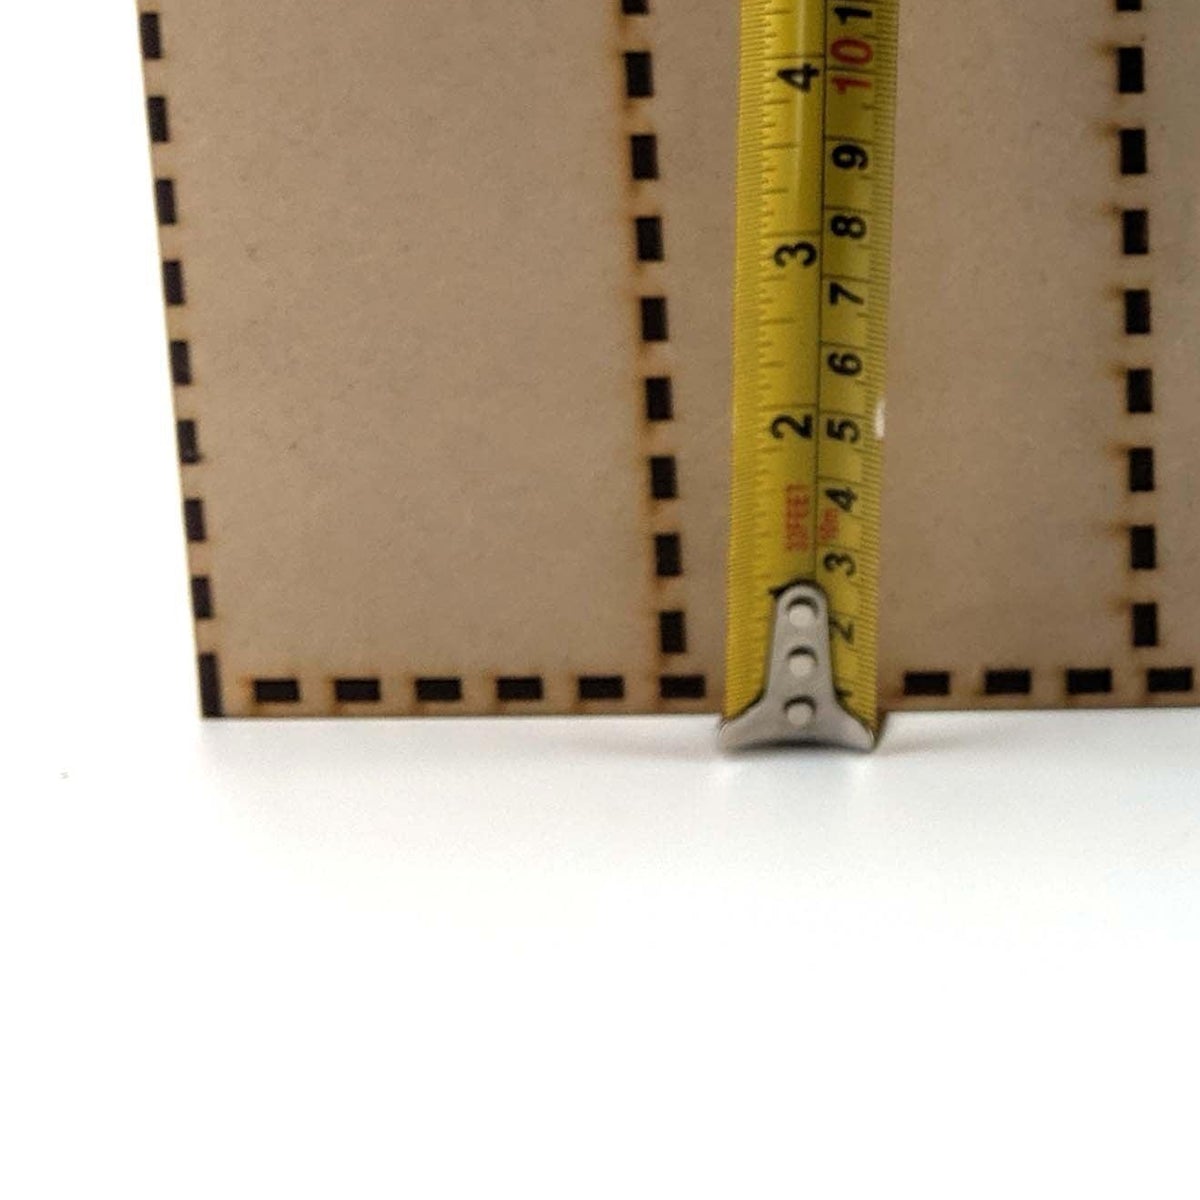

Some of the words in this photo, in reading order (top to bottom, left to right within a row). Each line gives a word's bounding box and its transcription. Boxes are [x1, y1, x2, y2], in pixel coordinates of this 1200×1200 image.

[834, 6, 873, 24] 1
[776, 63, 820, 92] 4
[830, 37, 874, 94] 10
[831, 144, 868, 170] 9
[830, 215, 867, 240] 8
[773, 241, 817, 267] 3
[829, 282, 864, 306] 7
[827, 352, 863, 377] 6
[771, 415, 813, 439] 2
[826, 418, 861, 444] 5
[825, 487, 858, 513] 4
[823, 552, 856, 577] 3
